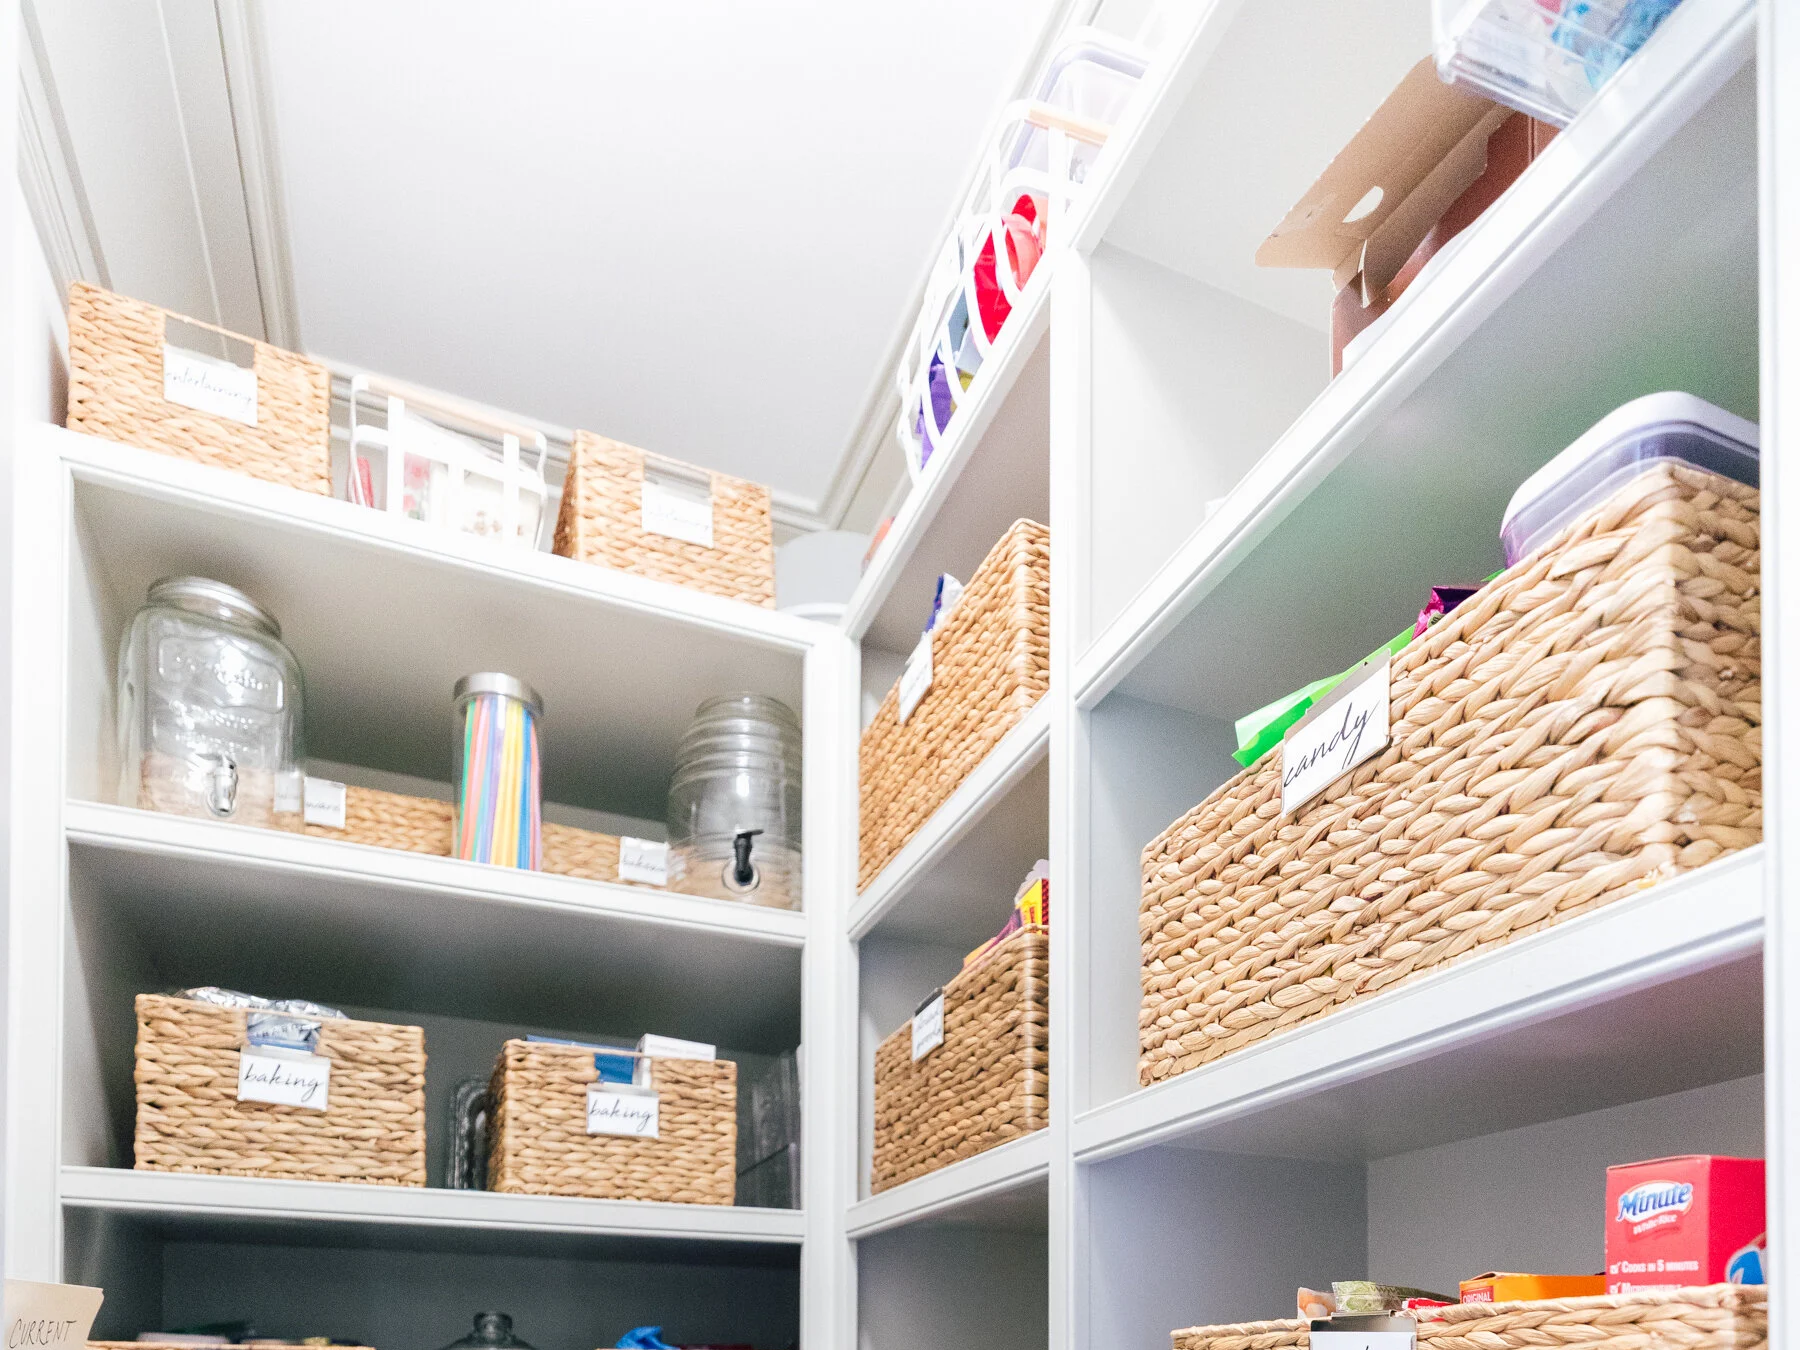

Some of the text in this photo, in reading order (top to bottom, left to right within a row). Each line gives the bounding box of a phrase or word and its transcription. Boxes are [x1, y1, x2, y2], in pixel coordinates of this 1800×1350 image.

[1283, 700, 1380, 788] candy
[244, 1063, 324, 1103] baking
[589, 1098, 654, 1132] baking
[1617, 1184, 1692, 1221] Minute
[1462, 1291, 1492, 1304] ORIGINAL
[9, 1318, 77, 1349] CURRENT
